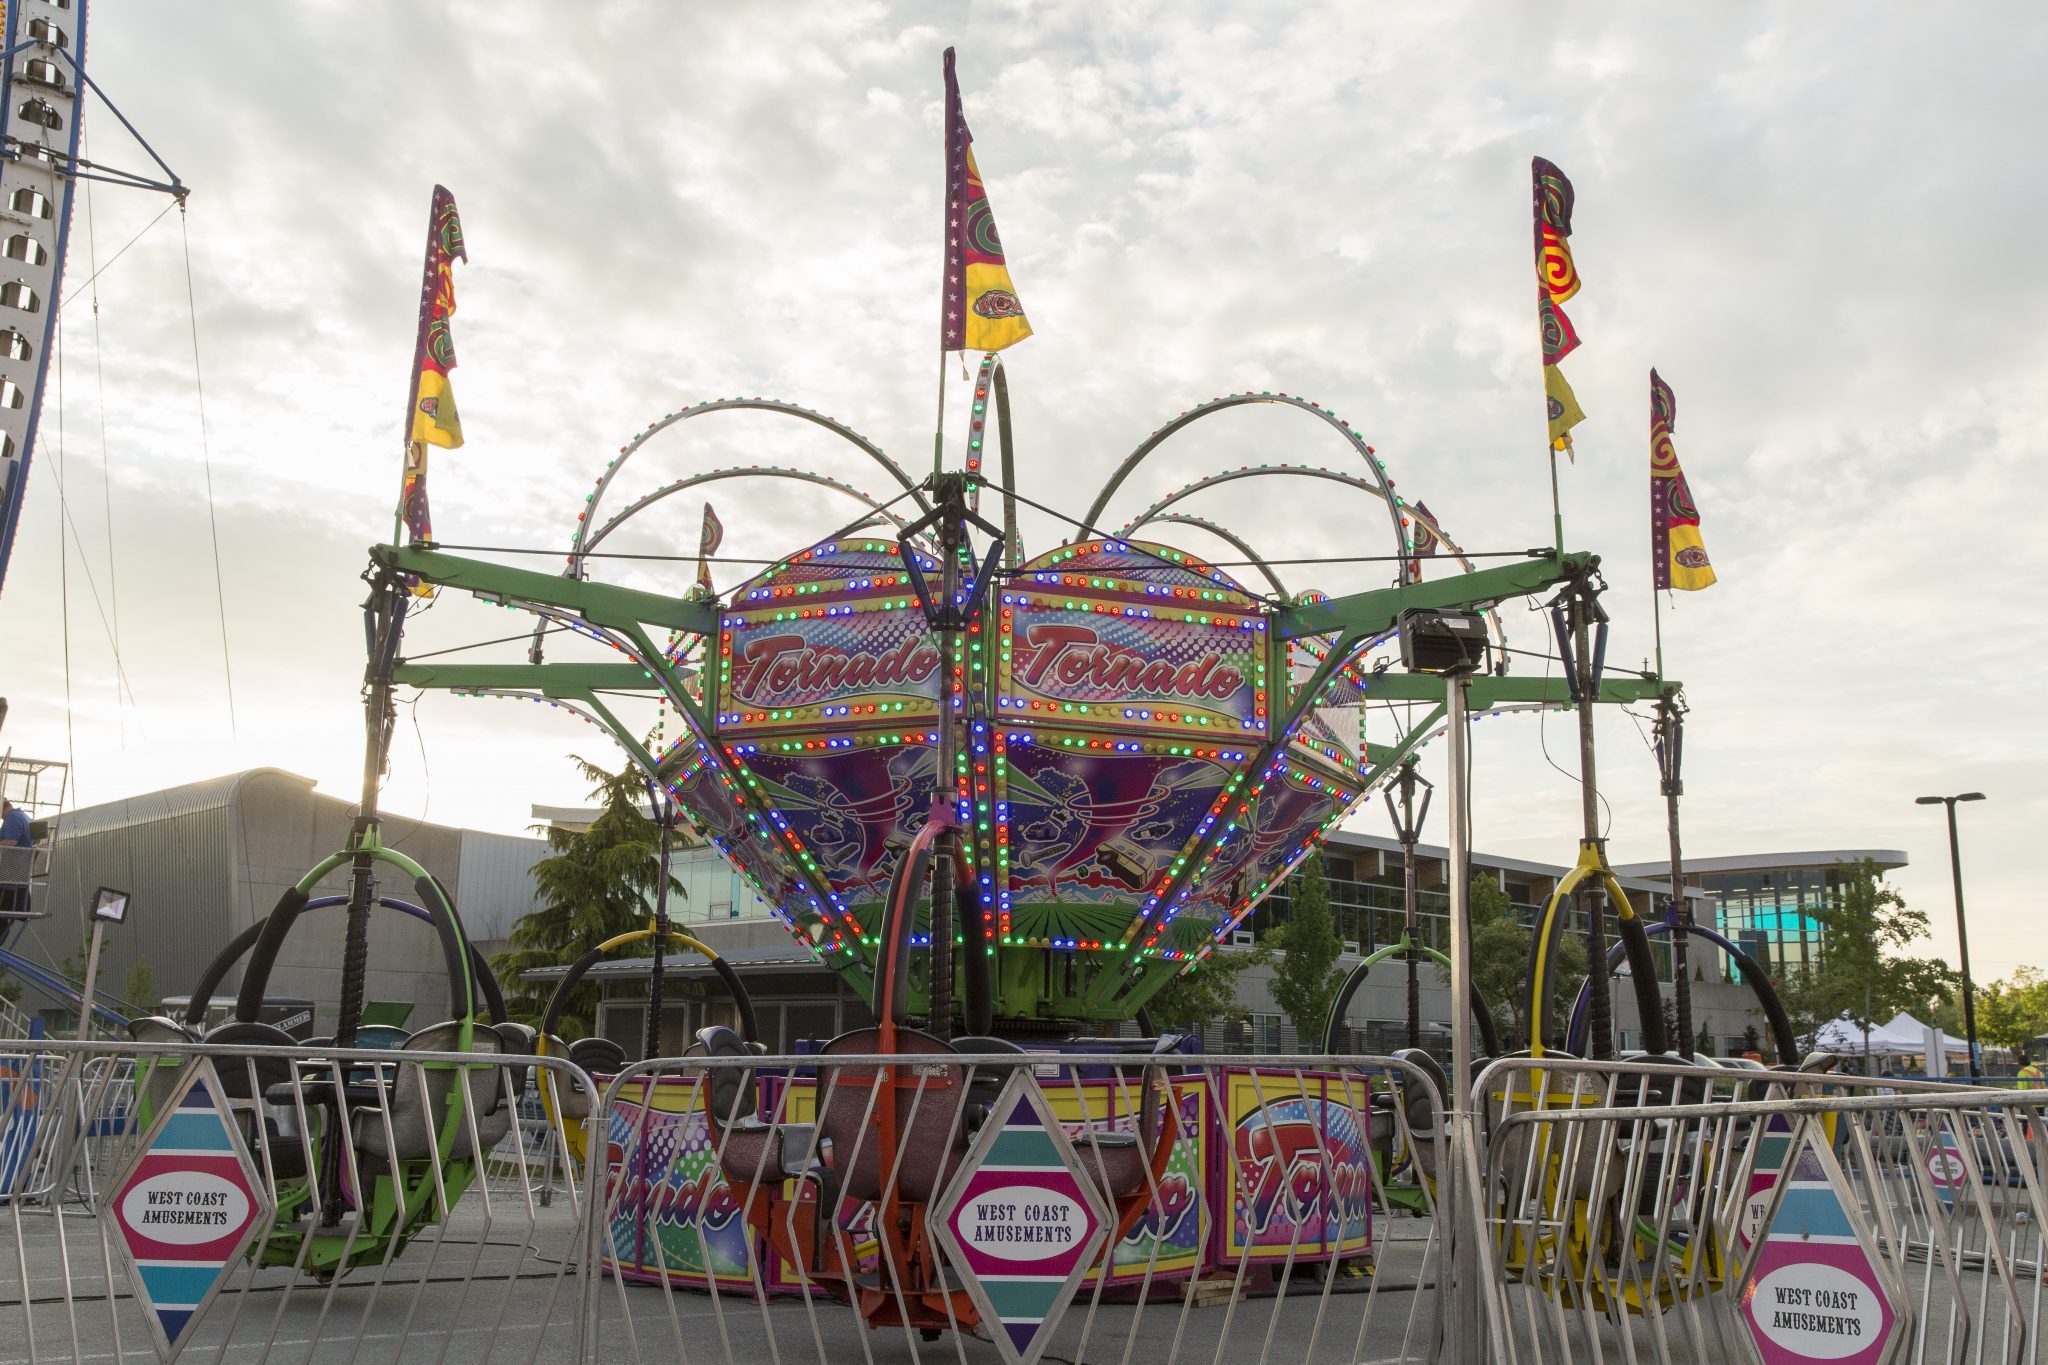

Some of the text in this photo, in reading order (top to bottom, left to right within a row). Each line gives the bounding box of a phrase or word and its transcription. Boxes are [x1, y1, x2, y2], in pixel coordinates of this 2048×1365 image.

[741, 634, 942, 700] Tornado
[1024, 624, 1246, 703] Tornado
[148, 1191, 227, 1206] WEST COAST
[142, 1210, 227, 1225] AMUSEMENTS
[977, 1204, 1069, 1222] WEST COAST
[974, 1225, 1072, 1243] AMUSEMENTS
[1775, 1287, 1857, 1310] WEST COAST
[1773, 1311, 1861, 1336] AMUSEMENTS
